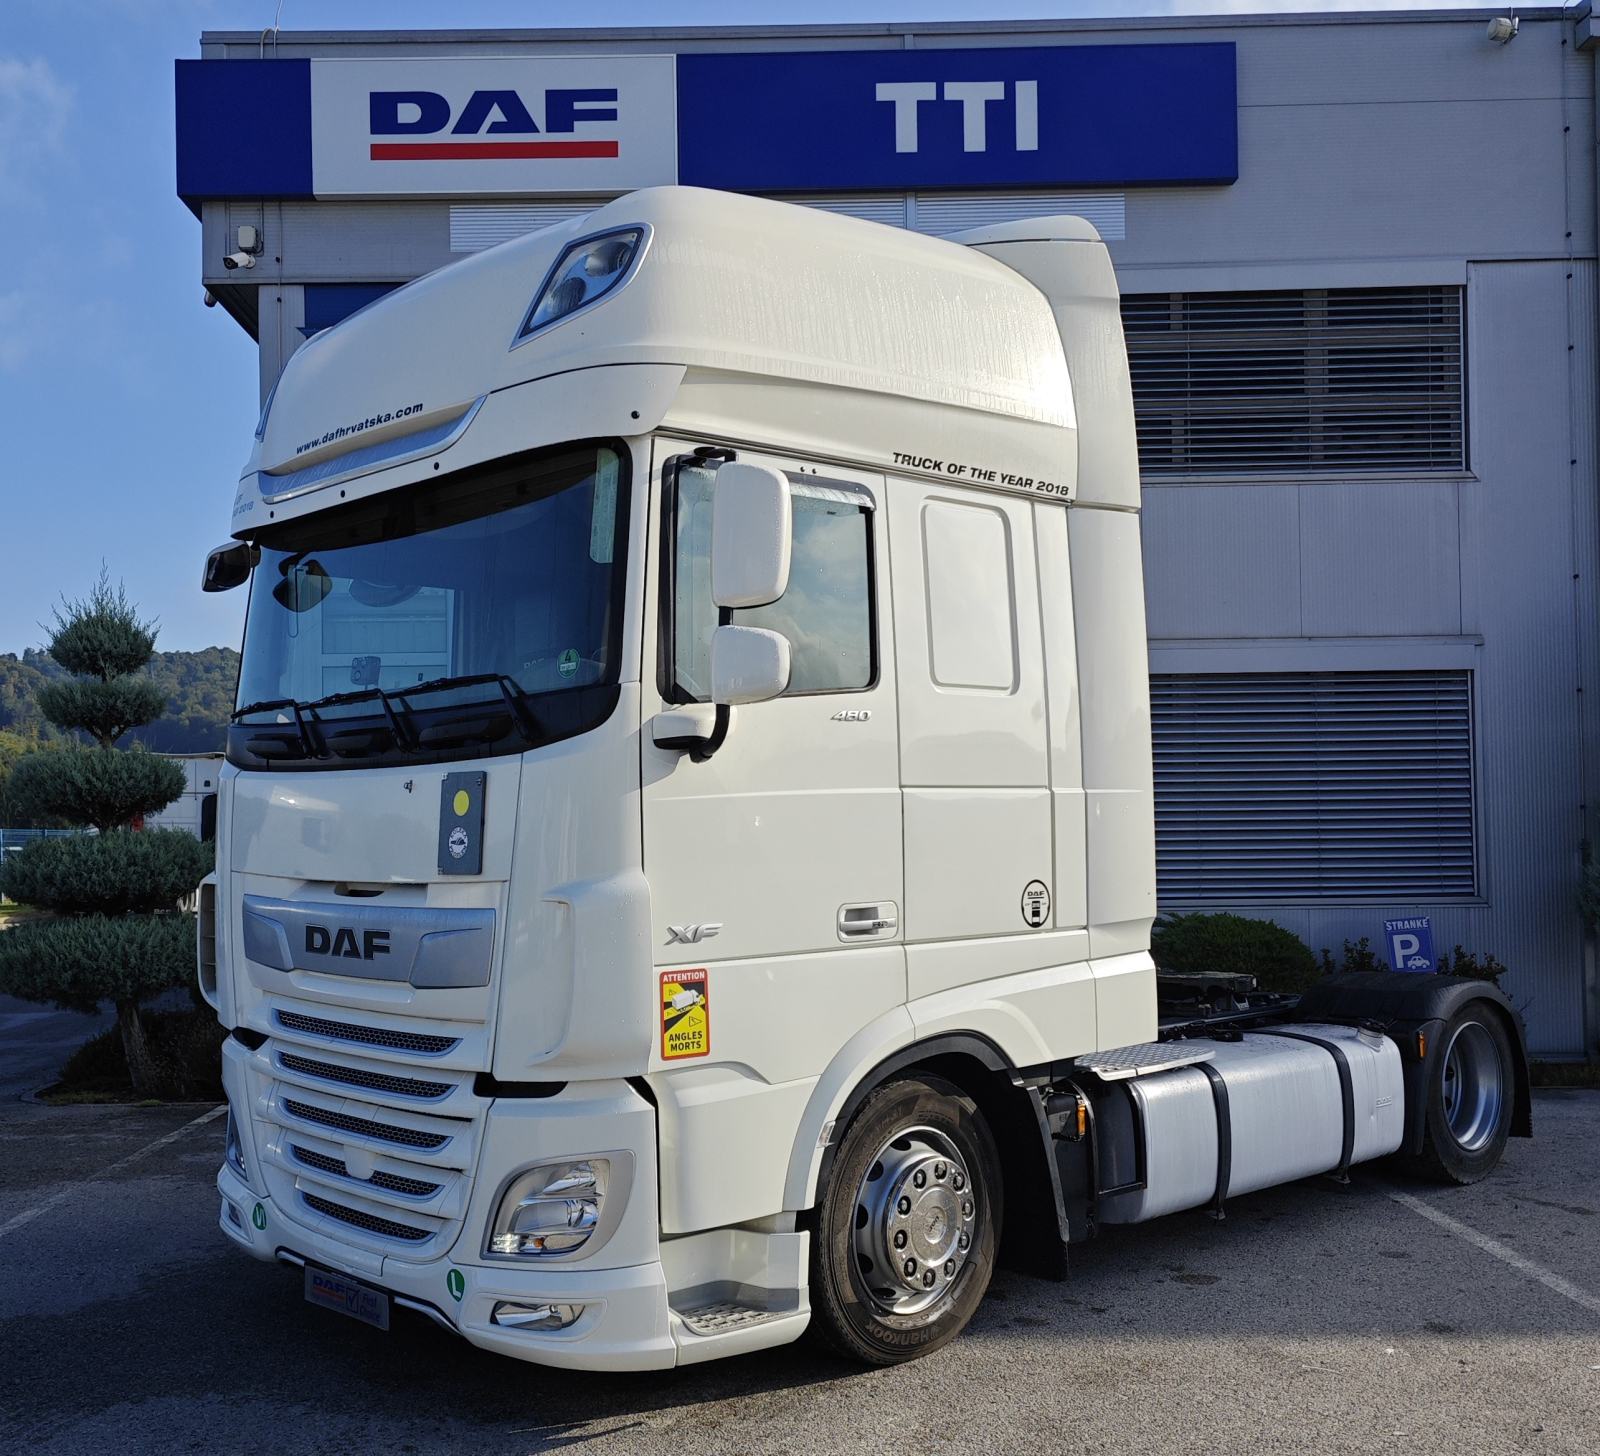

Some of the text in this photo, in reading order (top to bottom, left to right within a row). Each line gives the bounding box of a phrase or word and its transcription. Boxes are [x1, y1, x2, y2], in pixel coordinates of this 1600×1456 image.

[369, 88, 618, 135] DAF
[875, 80, 1039, 153] TTI
[296, 402, 424, 455] www.dafhrvatska.com
[892, 452, 1070, 496] TRUCK OF THE YEAR 2018
[830, 710, 871, 722] 480
[663, 923, 723, 946] XF
[1385, 919, 1429, 931] STRANKE
[305, 924, 391, 961] DAF
[1392, 933, 1420, 969] P
[663, 971, 705, 983] ATTENTION
[668, 1030, 703, 1043] ANGLES
[670, 1040, 702, 1052] MORTS
[450, 1271, 462, 1299] L
